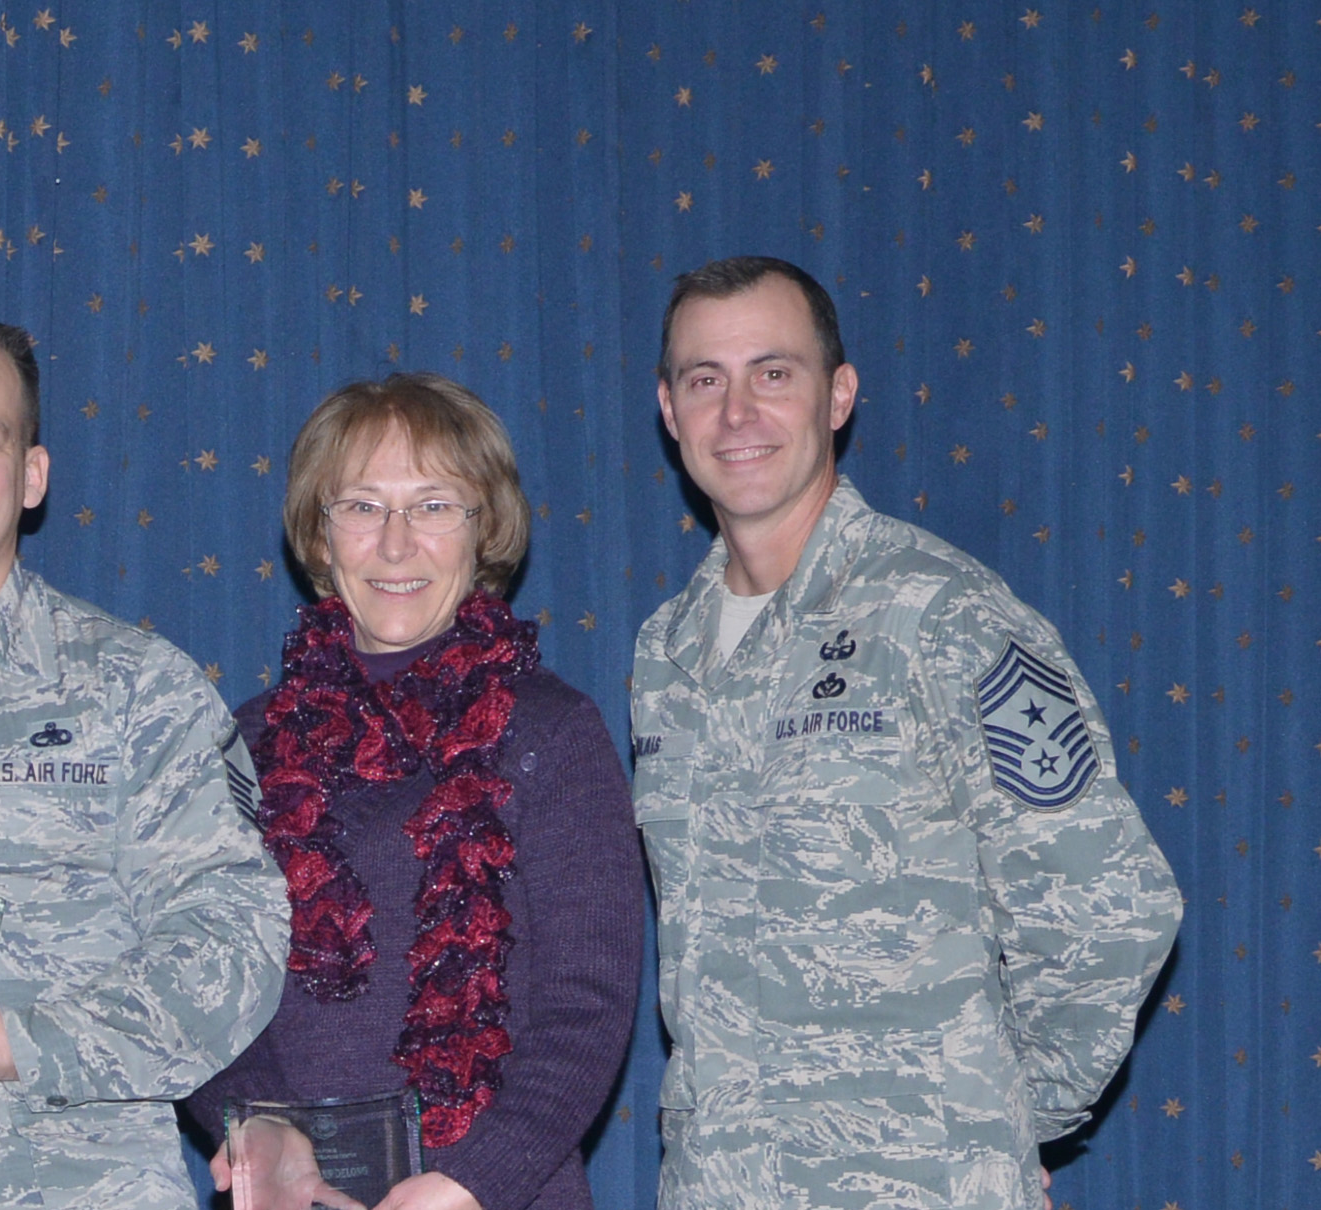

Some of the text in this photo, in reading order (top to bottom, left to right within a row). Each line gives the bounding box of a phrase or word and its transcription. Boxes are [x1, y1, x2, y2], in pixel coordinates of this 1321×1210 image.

[775, 710, 884, 740] U.S. AIR FORCE
[23, 761, 56, 783] AIR
[60, 762, 110, 785] FORCE
